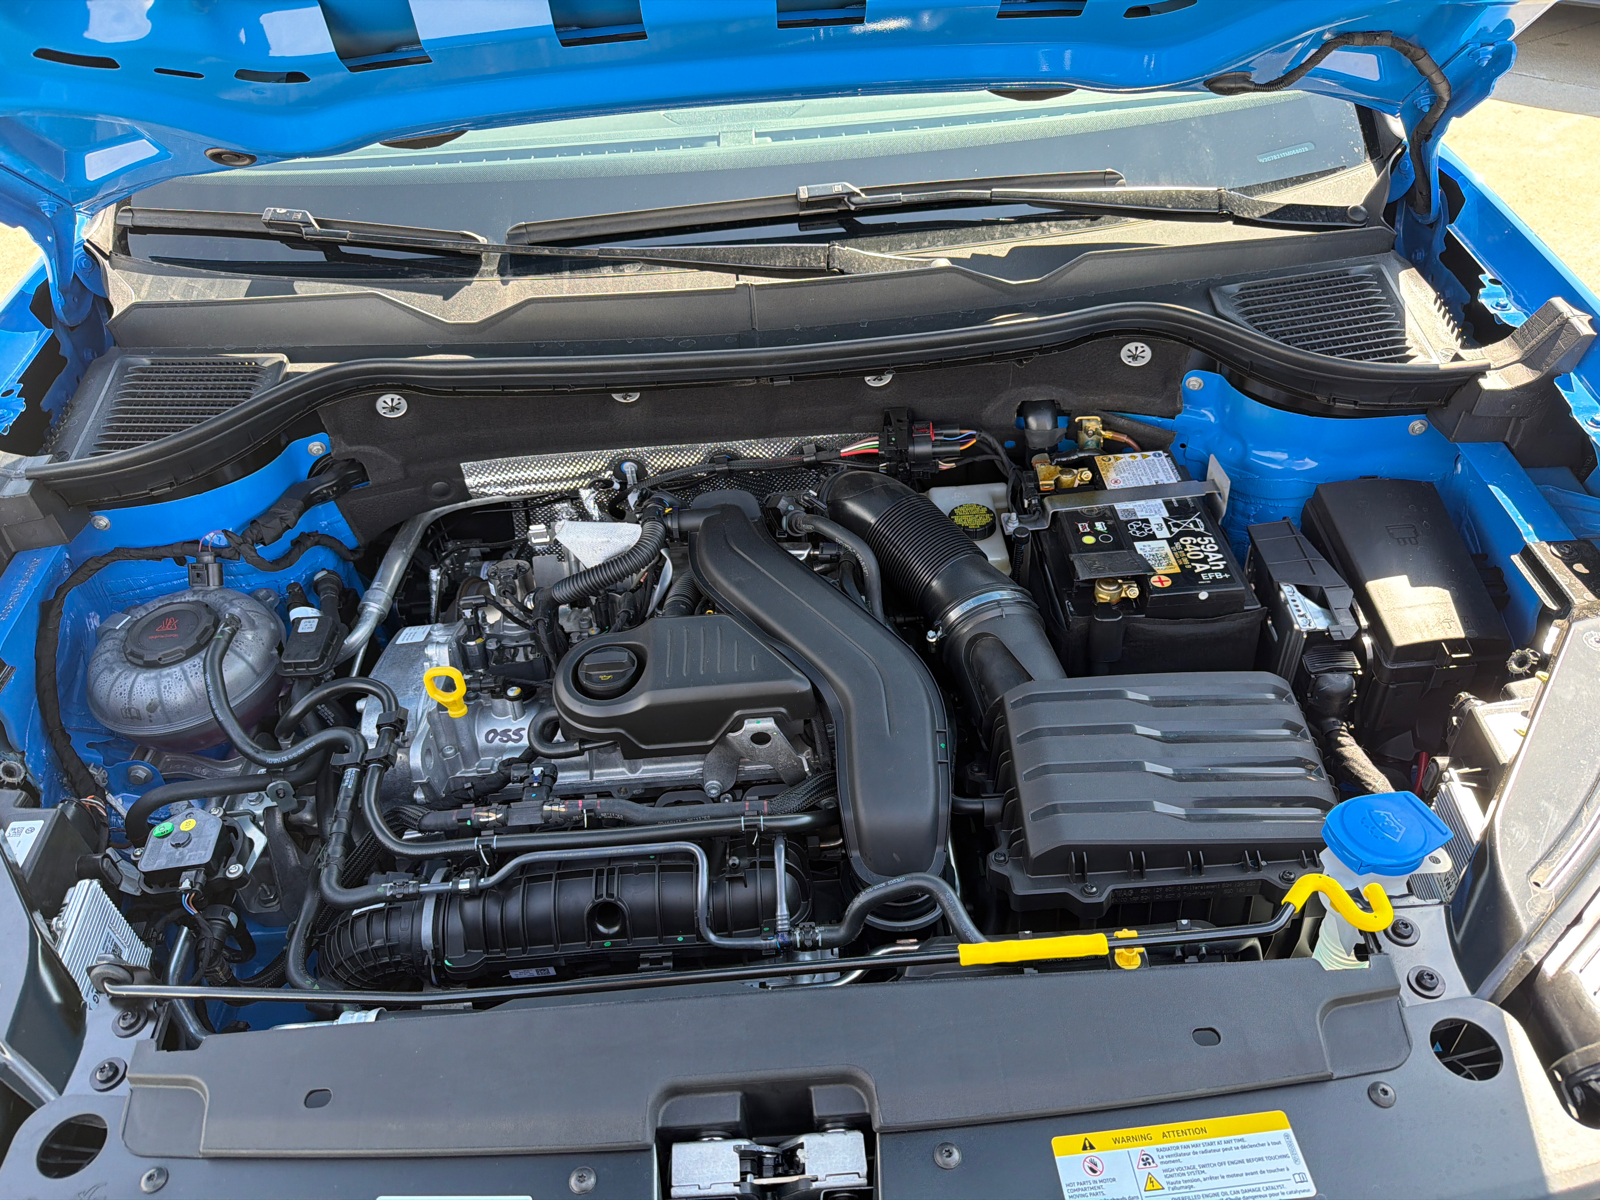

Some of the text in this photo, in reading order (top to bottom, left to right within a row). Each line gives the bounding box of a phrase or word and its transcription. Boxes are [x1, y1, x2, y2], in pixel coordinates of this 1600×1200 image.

[1180, 536, 1205, 559] 640
[1197, 536, 1227, 570] 59Ah
[1191, 562, 1211, 573] A
[1201, 572, 1231, 581] EFB+
[1111, 1127, 1208, 1145] WARNING ATTENTION
[1156, 1145, 1180, 1153] RADIATOR
[1265, 1153, 1290, 1161] TOUCHING
[1068, 1192, 1089, 1200] MOVING
